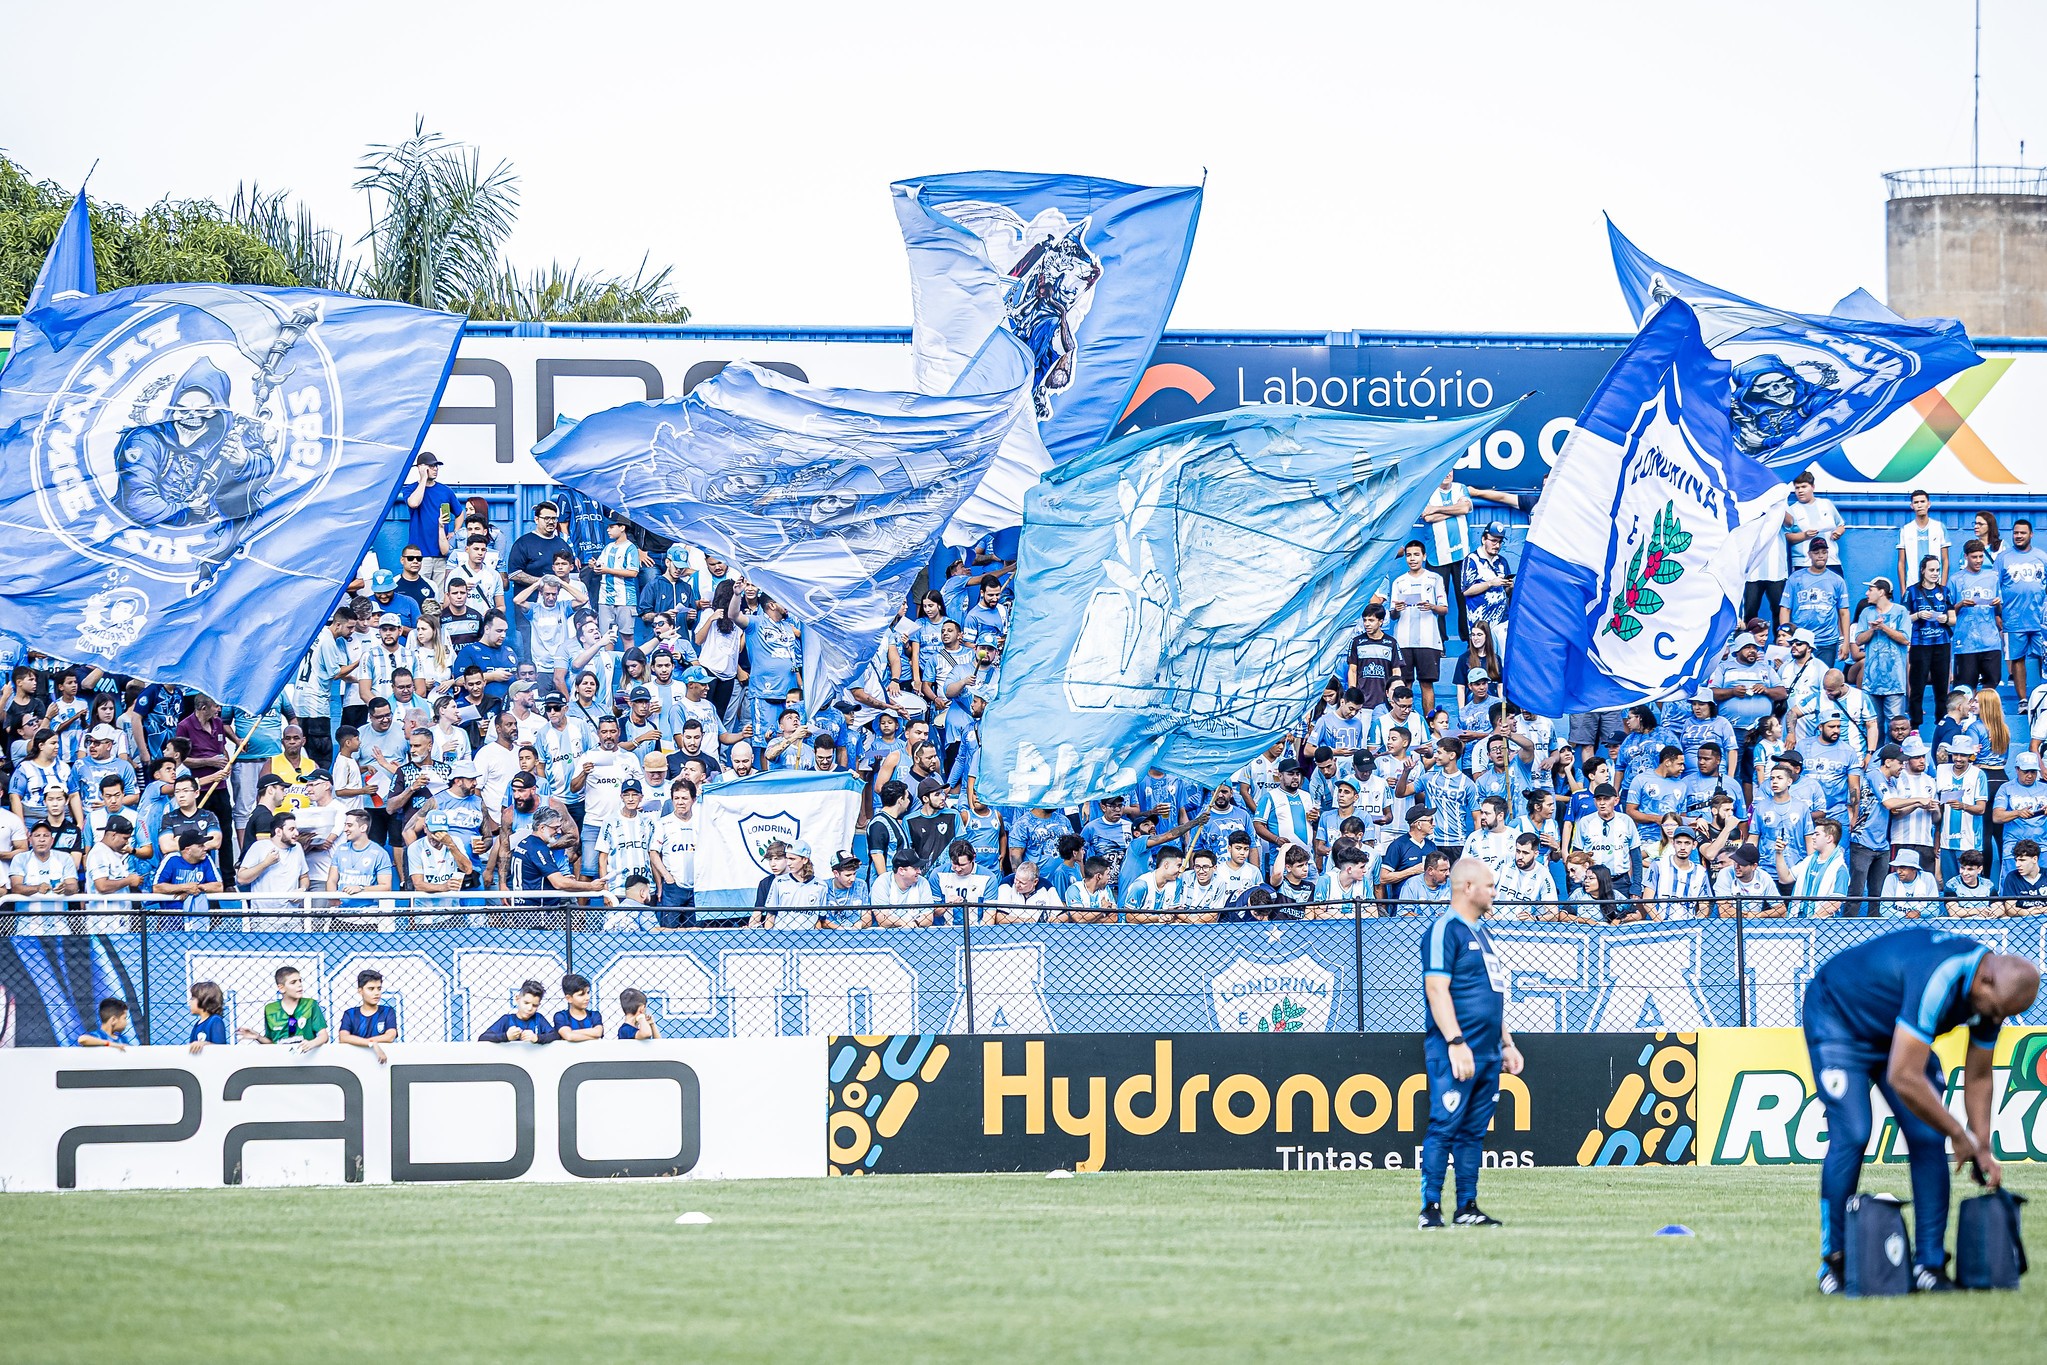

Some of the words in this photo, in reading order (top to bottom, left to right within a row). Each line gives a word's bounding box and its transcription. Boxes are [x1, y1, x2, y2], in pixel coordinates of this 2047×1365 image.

[1237, 365, 1494, 408] Laboratório
[1631, 445, 1719, 520] LONDRINA
[1653, 631, 1678, 661] C
[748, 823, 793, 837] LONDRINA
[1220, 976, 1328, 1004] LONDRINA
[55, 1060, 701, 1190] PADO
[1275, 1145, 1374, 1171] Tintas
[1384, 1151, 1403, 1171] e
